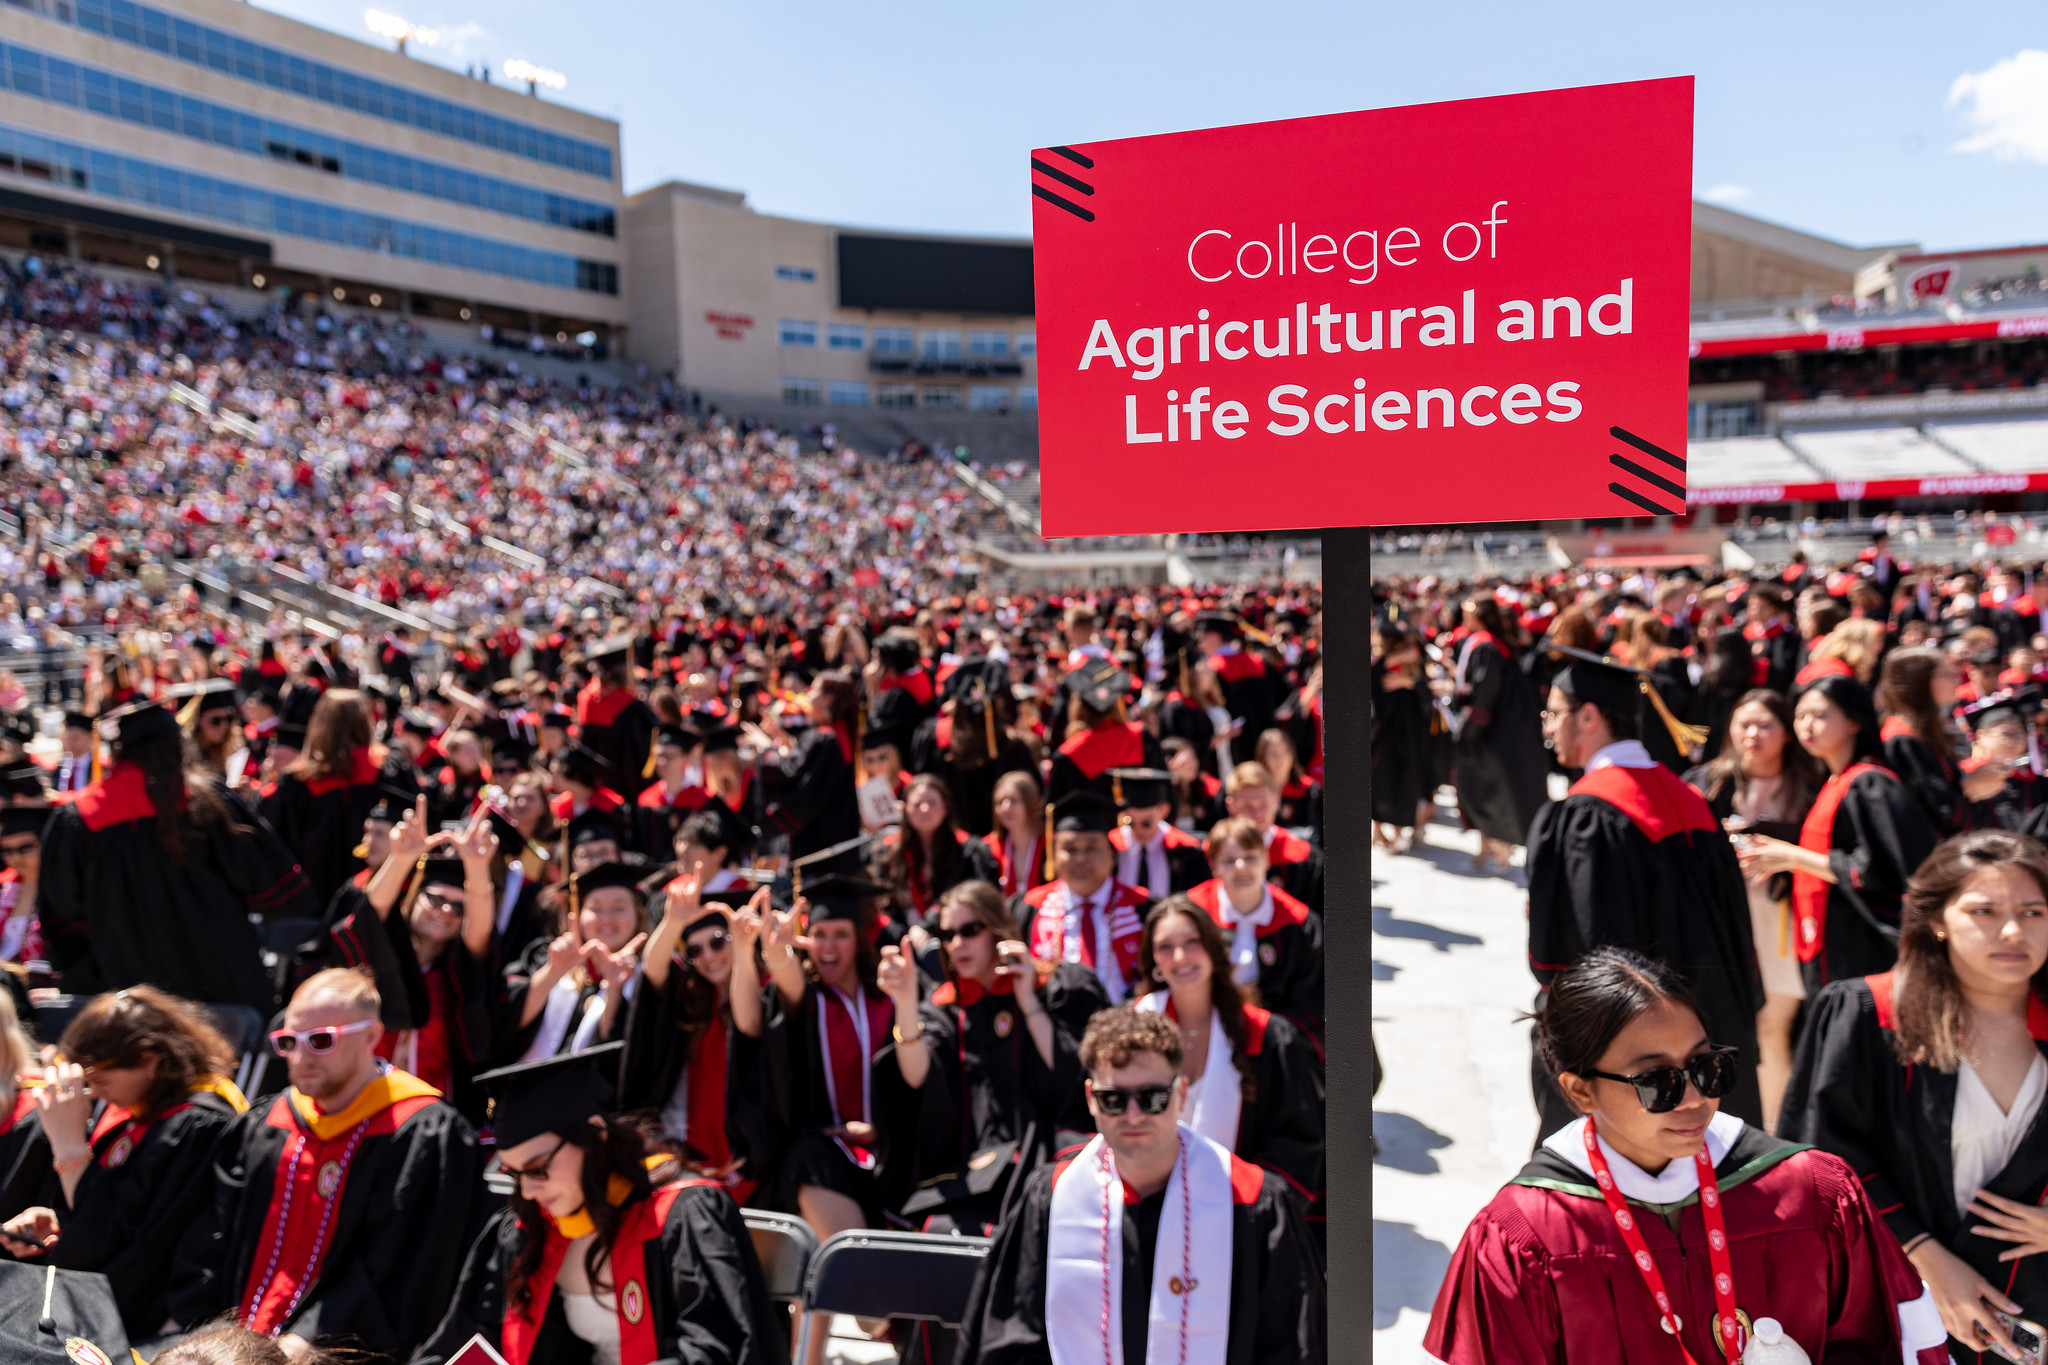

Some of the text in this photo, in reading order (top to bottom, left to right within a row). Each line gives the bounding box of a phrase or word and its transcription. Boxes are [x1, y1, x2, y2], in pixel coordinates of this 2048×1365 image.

[1188, 201, 1507, 284] College of
[1078, 278, 1632, 380] Agricultural and
[1126, 378, 1582, 444] Life Sciences
